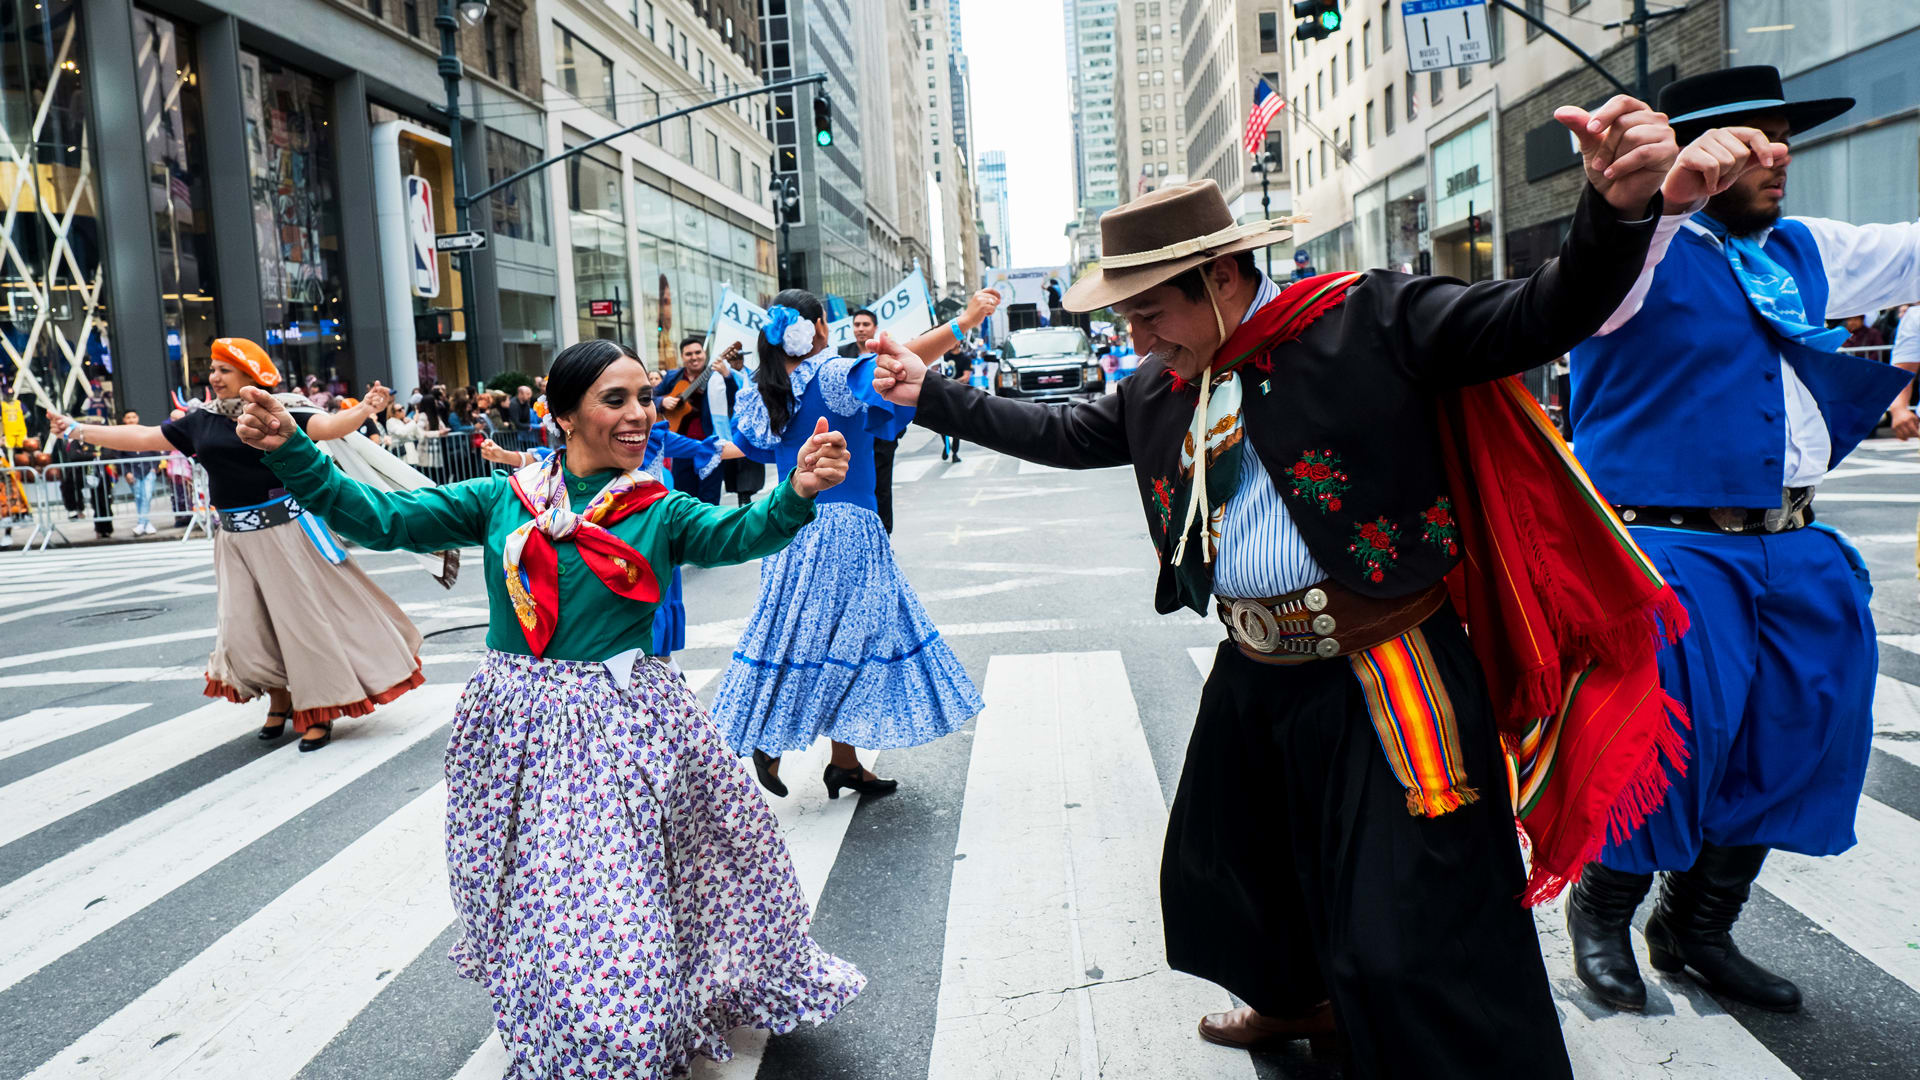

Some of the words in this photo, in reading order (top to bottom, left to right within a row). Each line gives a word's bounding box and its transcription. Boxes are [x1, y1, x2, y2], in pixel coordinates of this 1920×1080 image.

[1460, 41, 1480, 51] BUSES
[1419, 48, 1440, 58] BUSES
[1463, 53, 1480, 61] ONLY
[1422, 59, 1440, 67] ONLY
[439, 239, 455, 248] ONE
